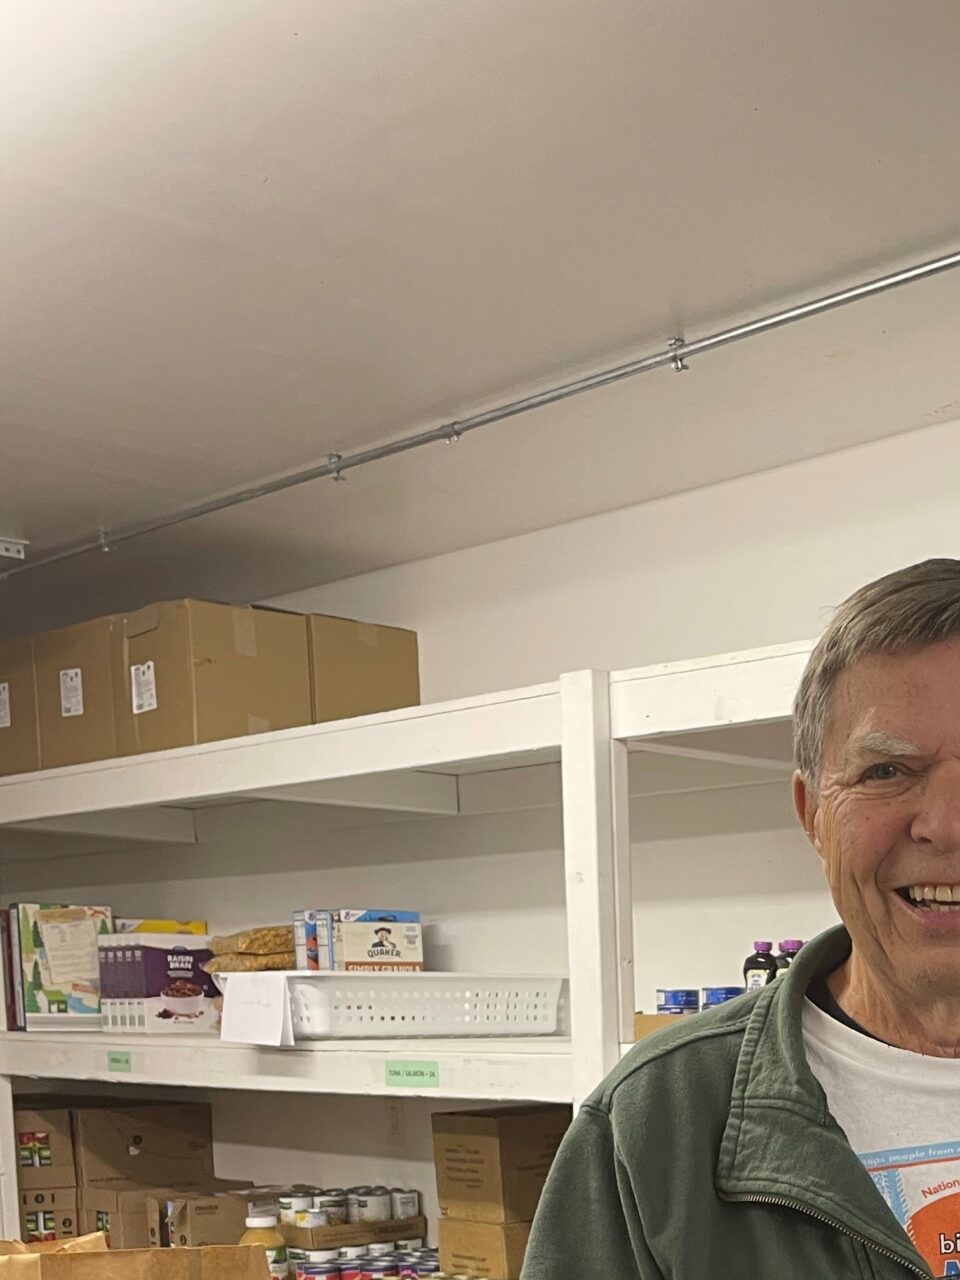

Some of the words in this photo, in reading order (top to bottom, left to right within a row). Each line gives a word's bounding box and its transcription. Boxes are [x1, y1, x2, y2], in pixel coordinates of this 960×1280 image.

[367, 948, 401, 958] QUAKER
[167, 954, 194, 963] RAISIN
[169, 962, 192, 970] BRAN
[888, 1150, 925, 1162] people
[928, 1147, 955, 1157] from
